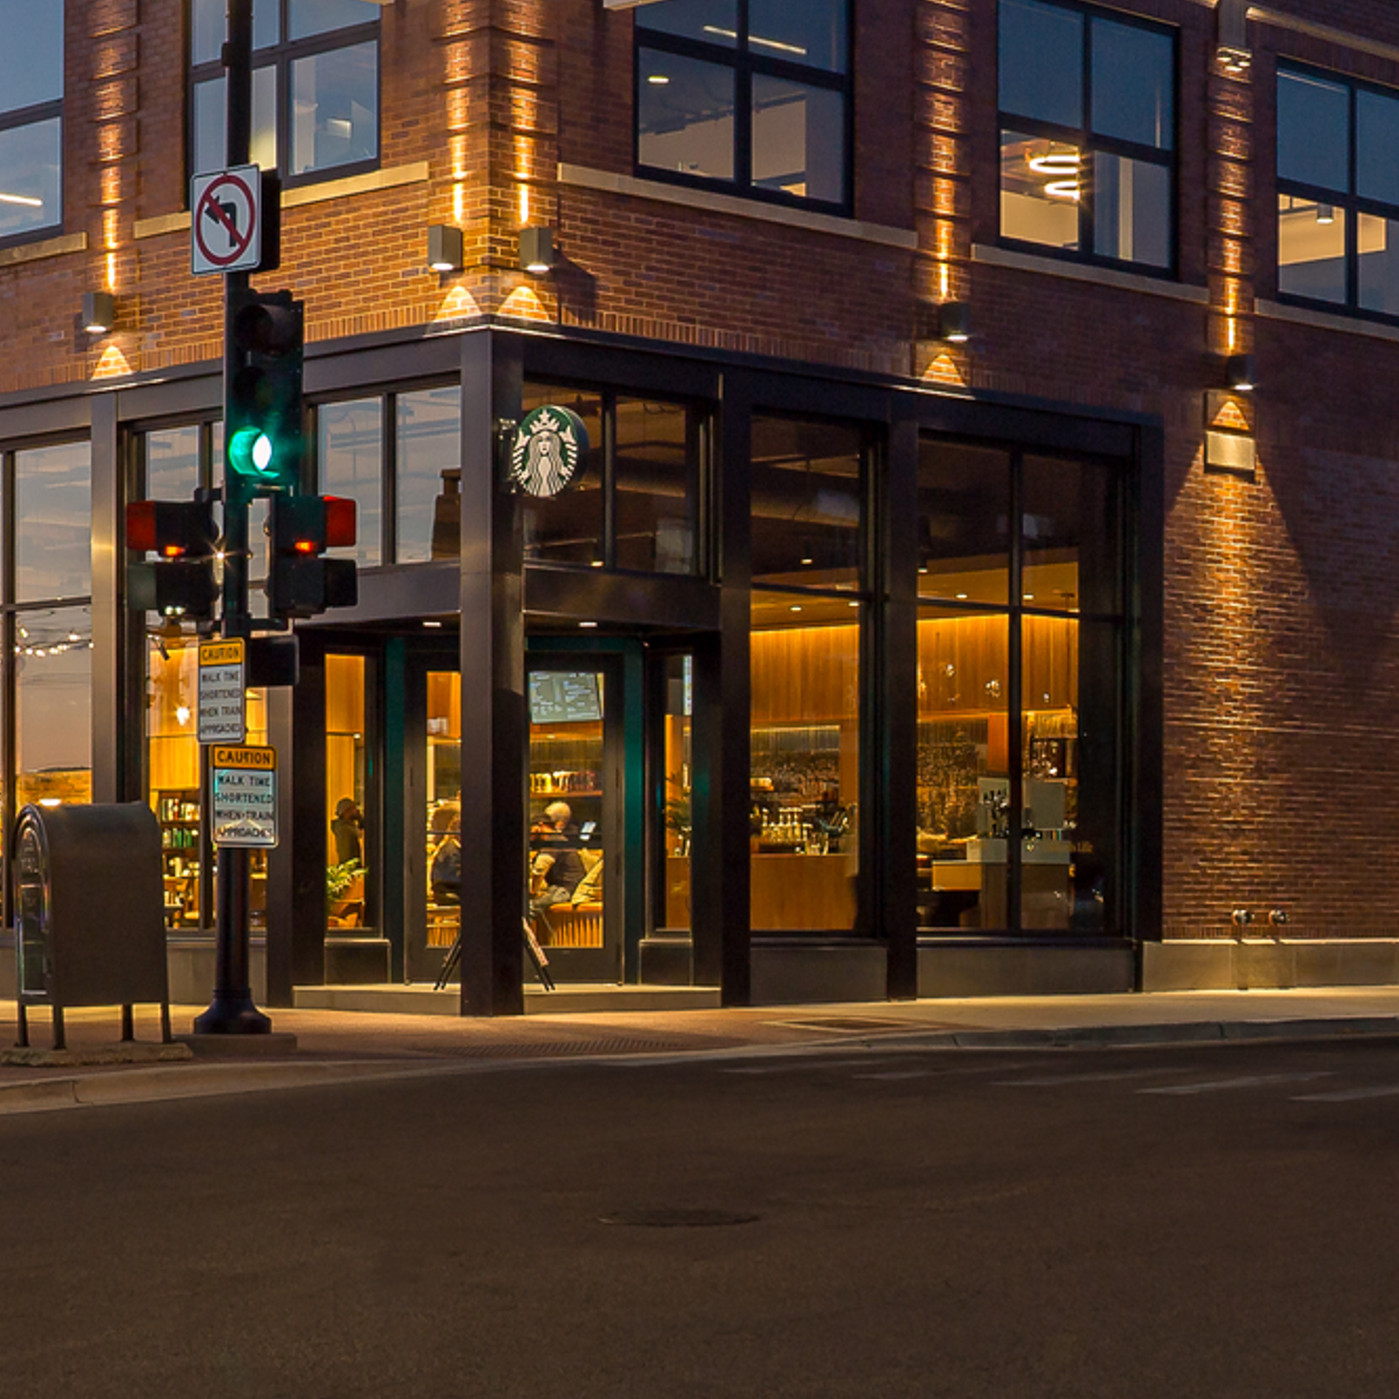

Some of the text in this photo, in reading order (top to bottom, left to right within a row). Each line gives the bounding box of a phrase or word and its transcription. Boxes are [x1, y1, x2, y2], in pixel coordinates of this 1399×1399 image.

[202, 647, 239, 661] CAUTION
[202, 671, 240, 682] WALK TIME
[217, 750, 271, 765] CAUTION
[217, 775, 271, 787] WALK TIME
[215, 791, 274, 804] SHORTENED
[216, 809, 273, 820] WHEN TRAIN
